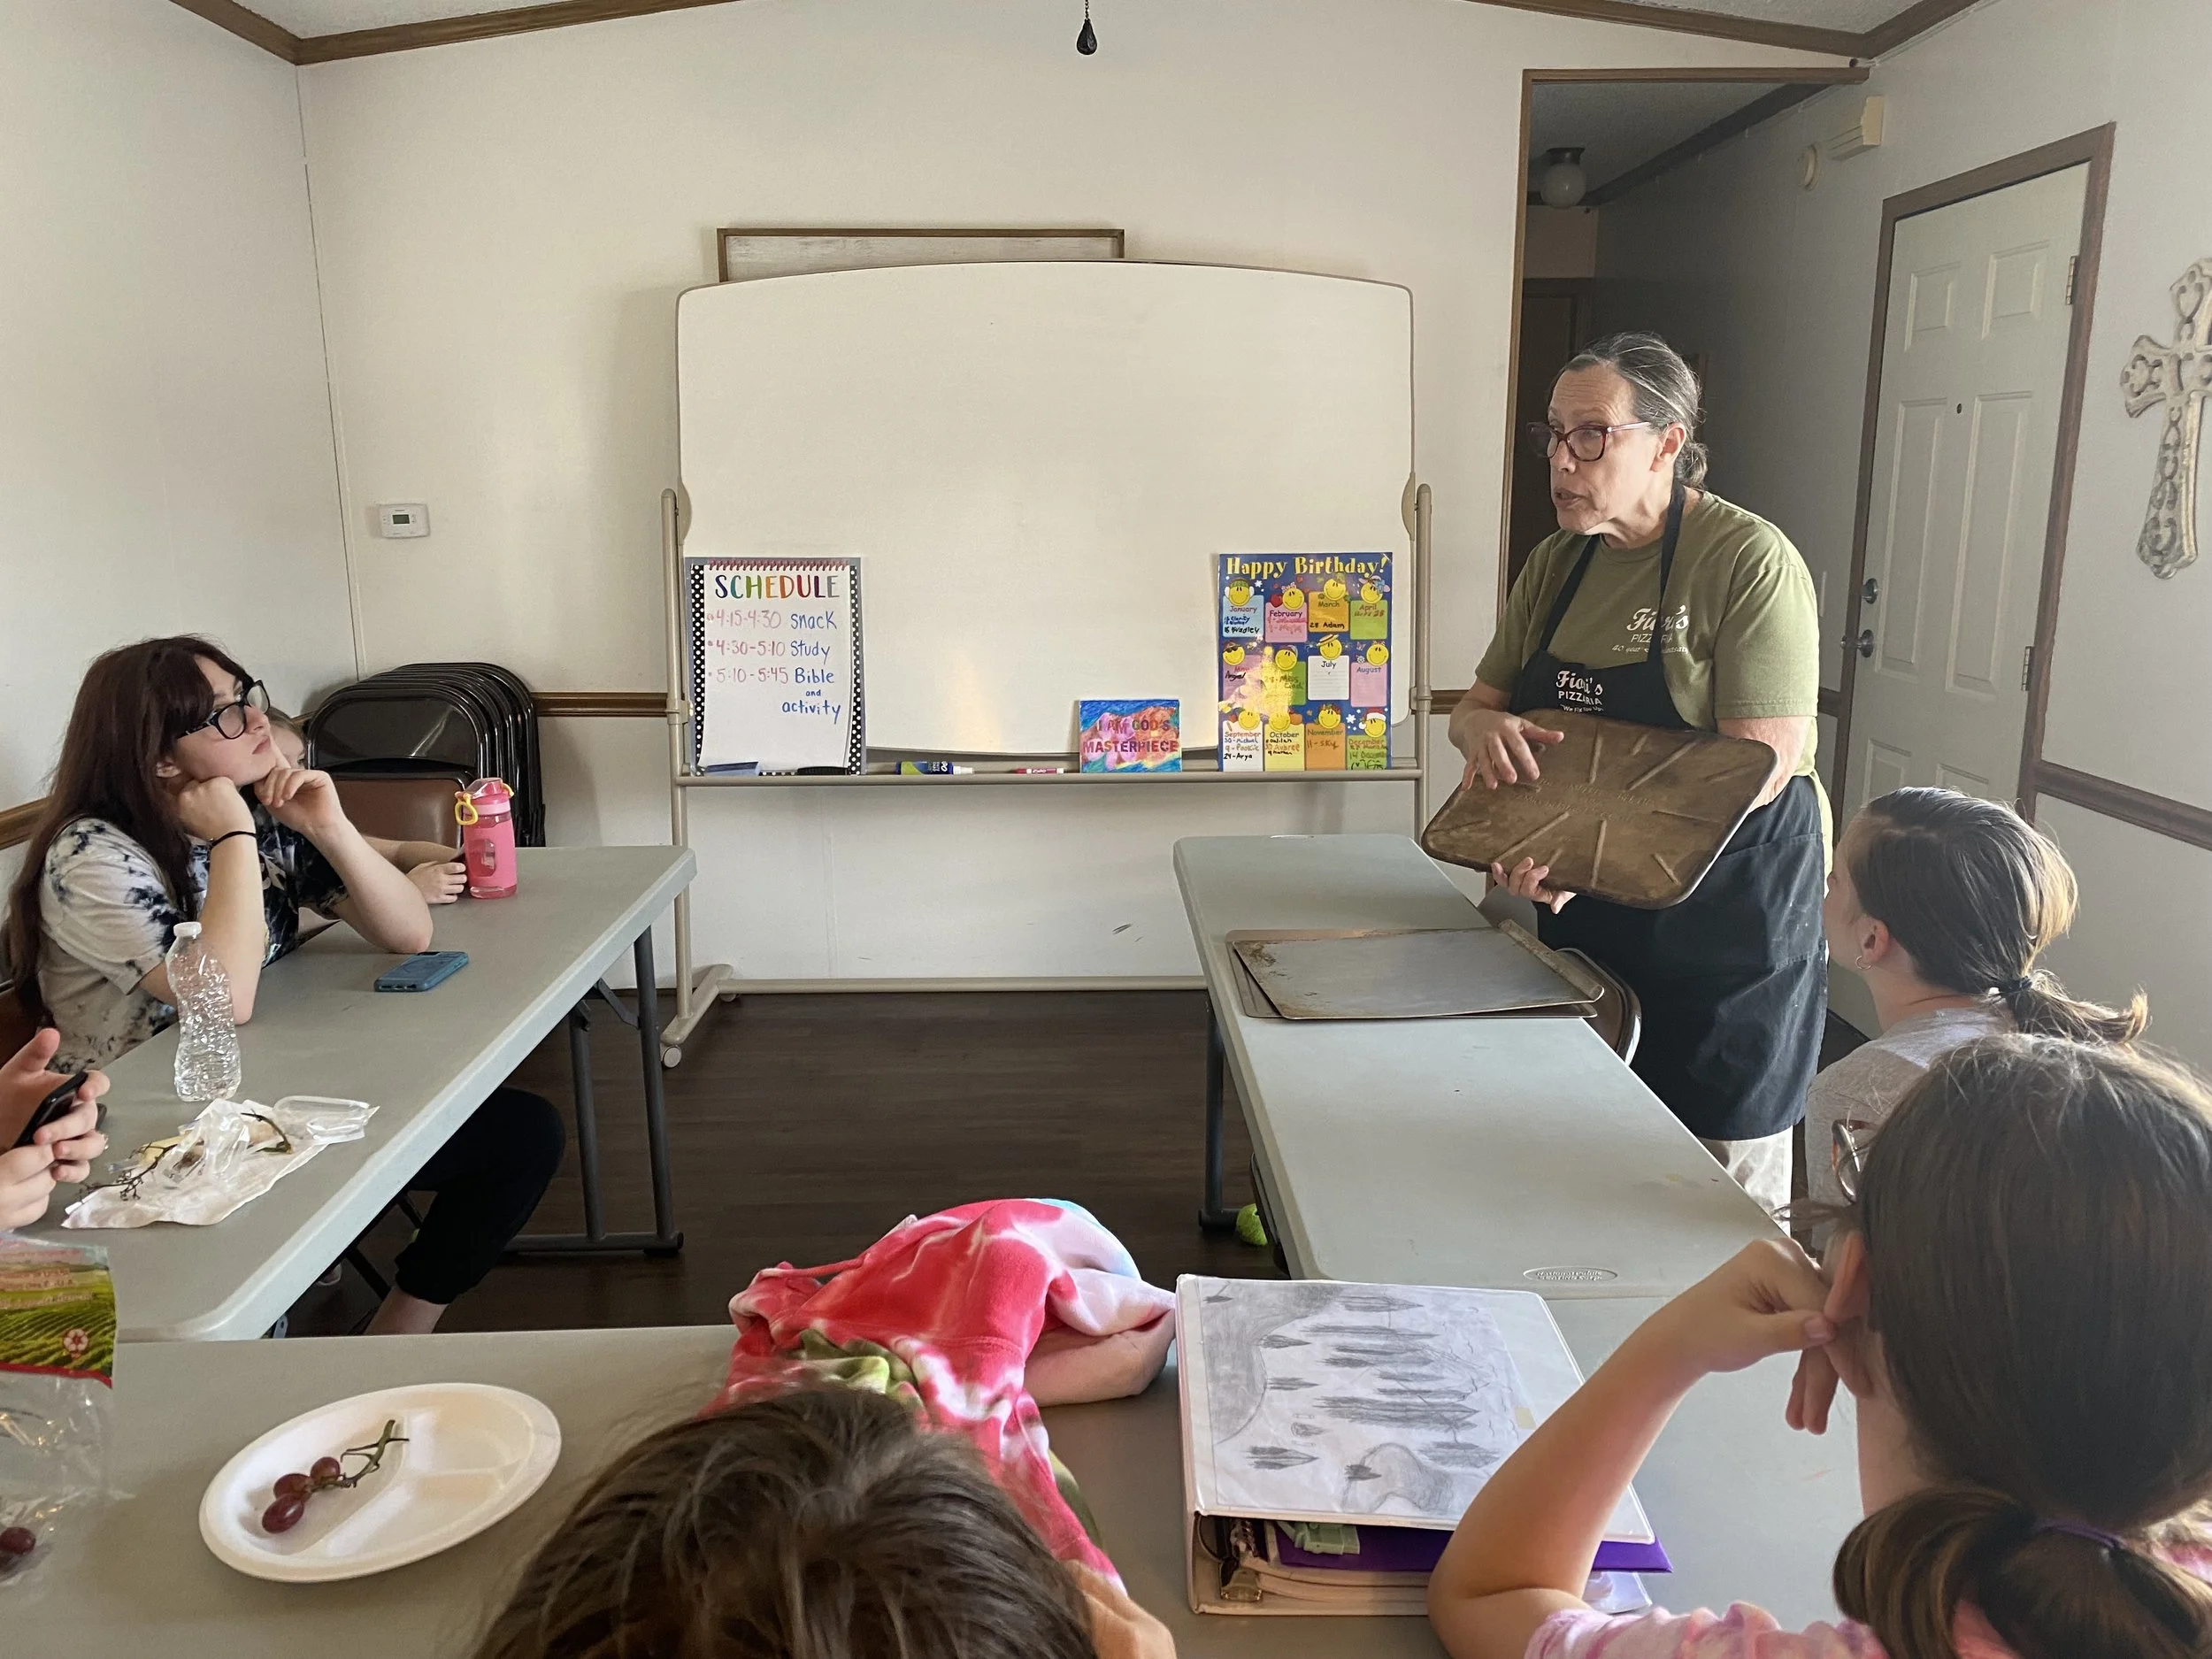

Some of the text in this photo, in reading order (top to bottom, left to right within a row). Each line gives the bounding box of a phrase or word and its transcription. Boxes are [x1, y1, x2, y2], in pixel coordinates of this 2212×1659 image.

[1226, 556, 1388, 580] Happy Birthday!
[715, 575, 840, 599] SCHEDULE
[1269, 610, 1303, 618] February
[1359, 604, 1377, 613] April
[1321, 660, 1337, 669] July
[795, 667, 835, 684] Bible
[782, 699, 841, 725] activity
[1098, 719, 1102, 731] I
[1107, 719, 1128, 734] AM
[1082, 740, 1179, 753] MASTERPIECE
